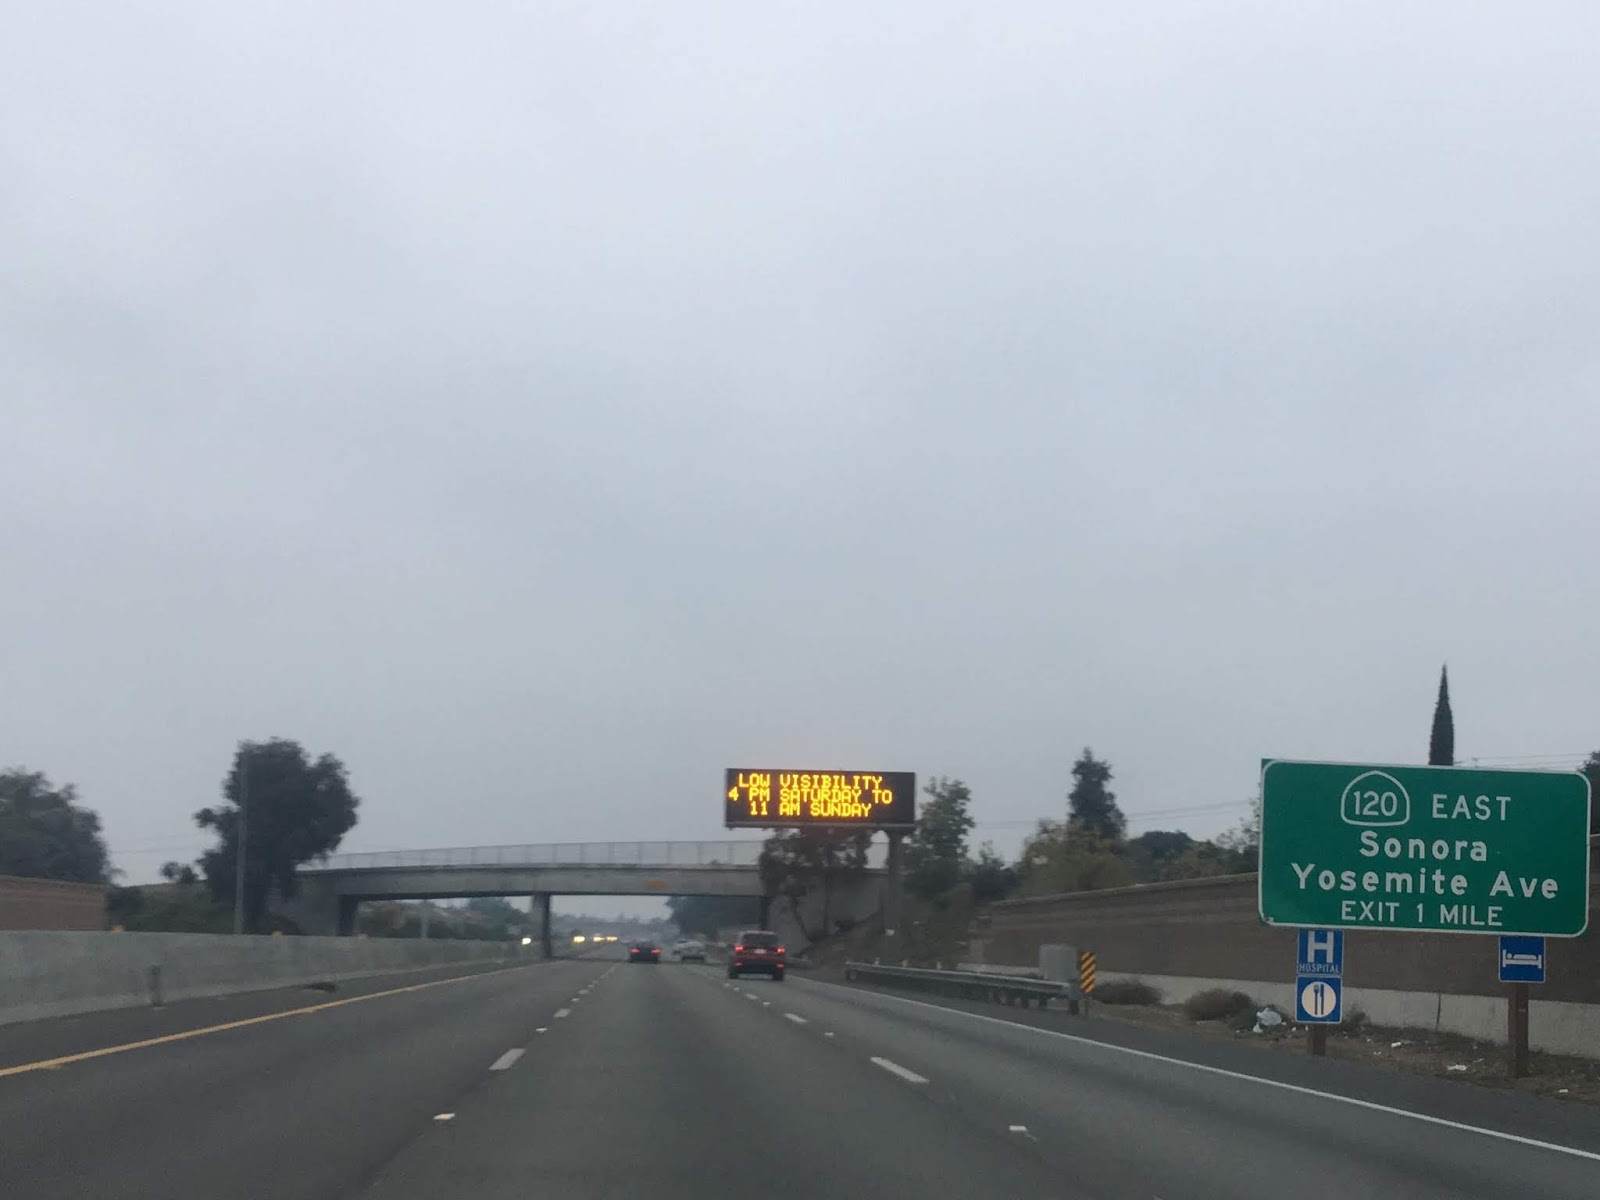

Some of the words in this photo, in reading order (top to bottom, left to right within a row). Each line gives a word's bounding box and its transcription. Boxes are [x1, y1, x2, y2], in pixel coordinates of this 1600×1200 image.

[738, 773, 770, 788] LOW
[779, 774, 883, 790] VISIBILITY
[728, 787, 739, 801] 4
[749, 788, 770, 802] PM
[780, 788, 862, 803] SATURDAY
[872, 790, 893, 805] TO
[750, 801, 768, 815] 11
[779, 802, 801, 816] AM
[810, 803, 872, 817] SUNDAY
[1353, 791, 1398, 817] 120
[1432, 794, 1511, 821] EAST
[1359, 830, 1488, 861] Sonora
[1290, 862, 1468, 895] Yosemite
[1489, 870, 1558, 899] Ave
[1341, 900, 1400, 922] EXIT
[1416, 903, 1424, 923] 1
[1440, 904, 1503, 926] MILE
[1307, 930, 1334, 963] H
[1299, 963, 1340, 974] HOSPITAL
